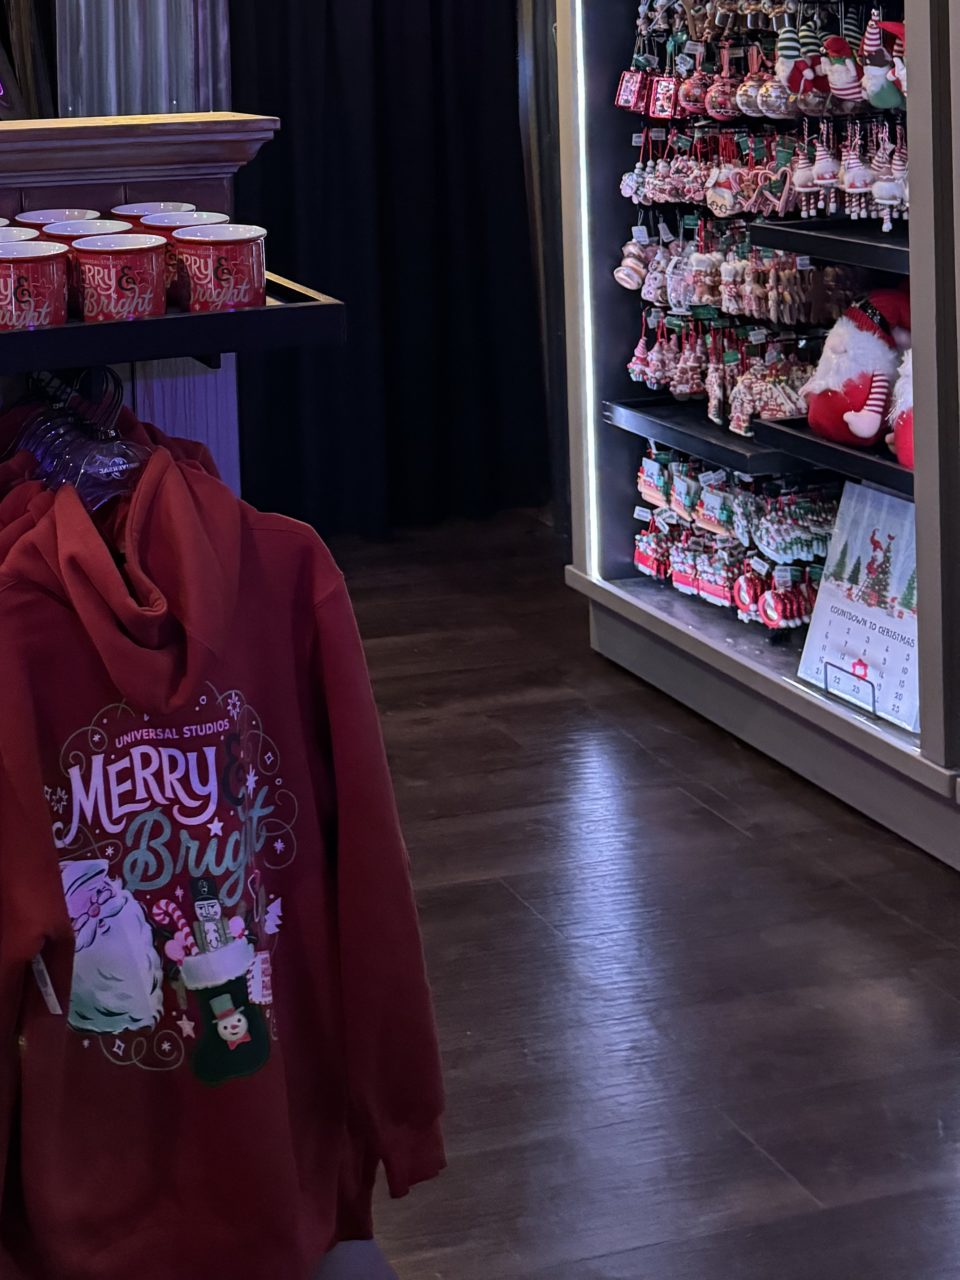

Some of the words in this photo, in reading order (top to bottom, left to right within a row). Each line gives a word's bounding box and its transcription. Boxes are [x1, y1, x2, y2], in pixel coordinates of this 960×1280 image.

[118, 265, 137, 292] &
[214, 256, 234, 282] &
[14, 276, 33, 304] &
[83, 282, 154, 319] Bright
[830, 604, 868, 628] COUNTDOWN
[868, 621, 877, 631] TO
[878, 625, 916, 649] CHRISTMAS
[114, 727, 180, 749] UNIVERSAL
[182, 719, 230, 738] STUDIOS
[51, 744, 219, 848] MERRY
[122, 785, 275, 907] Brigt
